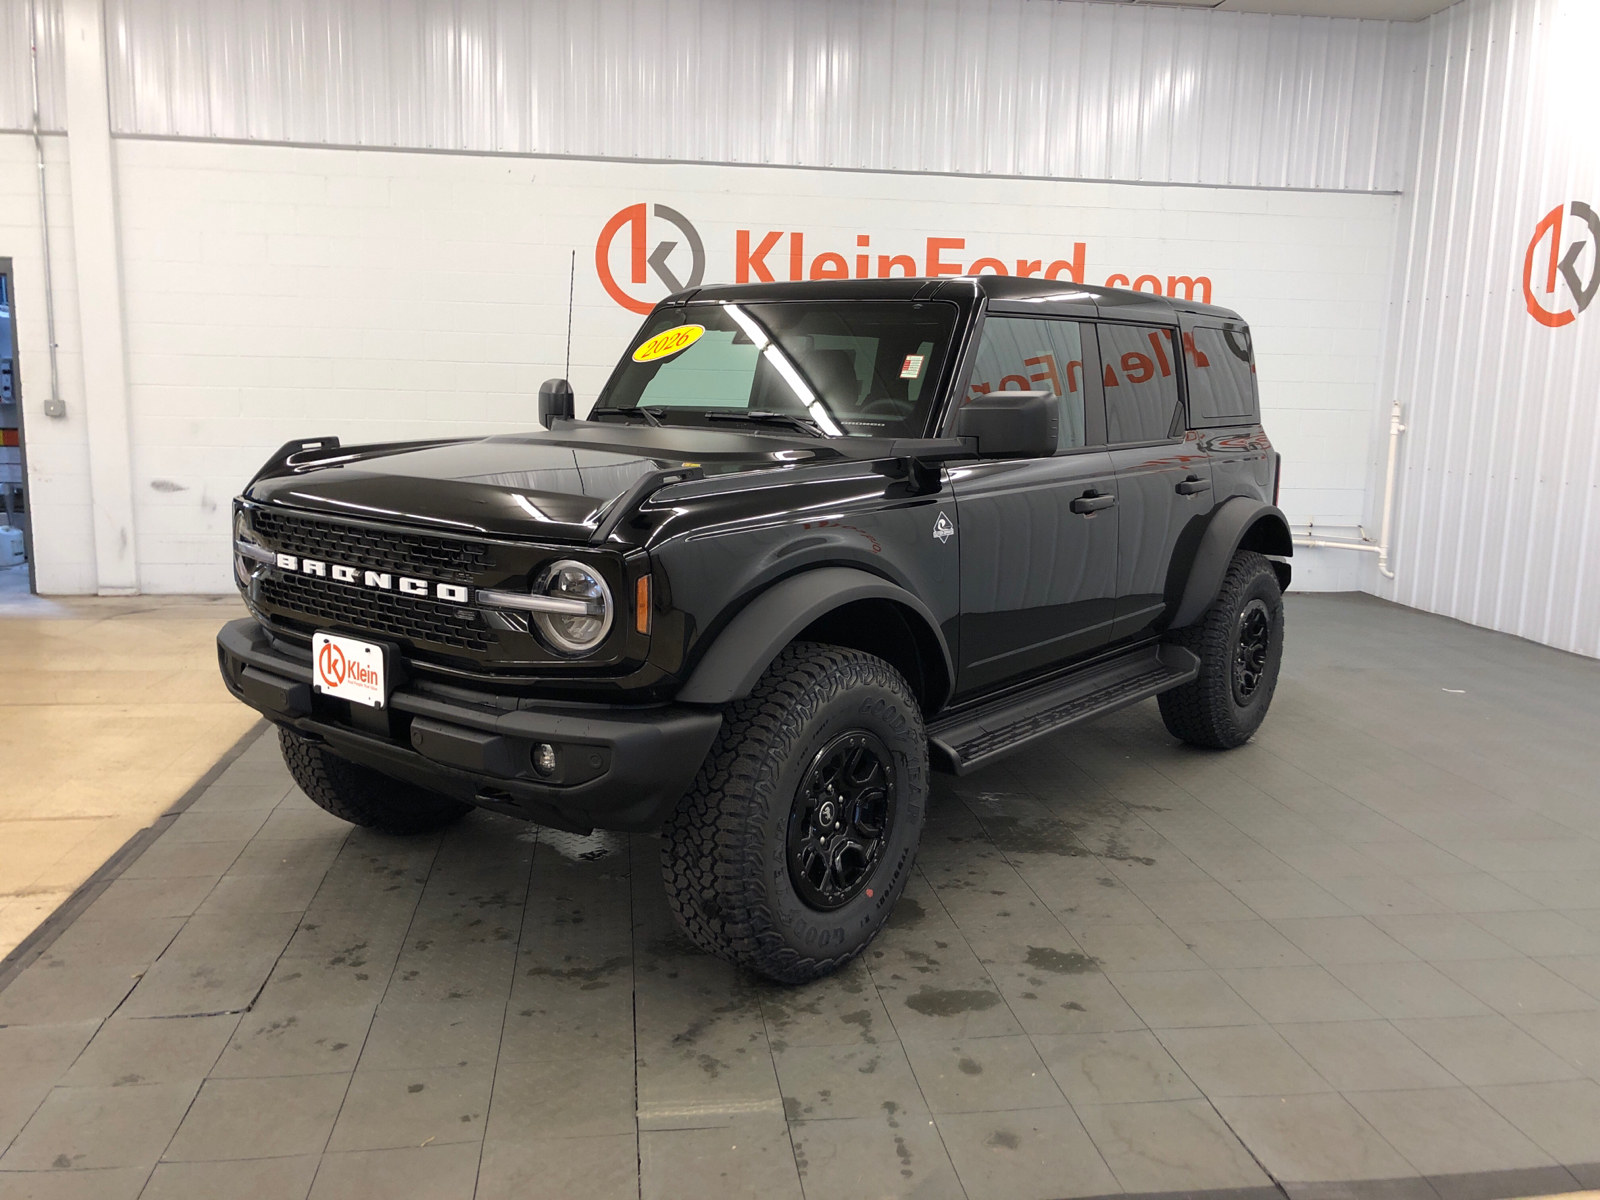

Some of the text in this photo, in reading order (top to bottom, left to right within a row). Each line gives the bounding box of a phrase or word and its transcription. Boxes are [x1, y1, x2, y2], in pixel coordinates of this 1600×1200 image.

[736, 230, 1212, 305] KleinFordcom
[641, 328, 695, 359] 2026
[277, 553, 468, 602] BRONCO
[347, 660, 378, 686] Klein
